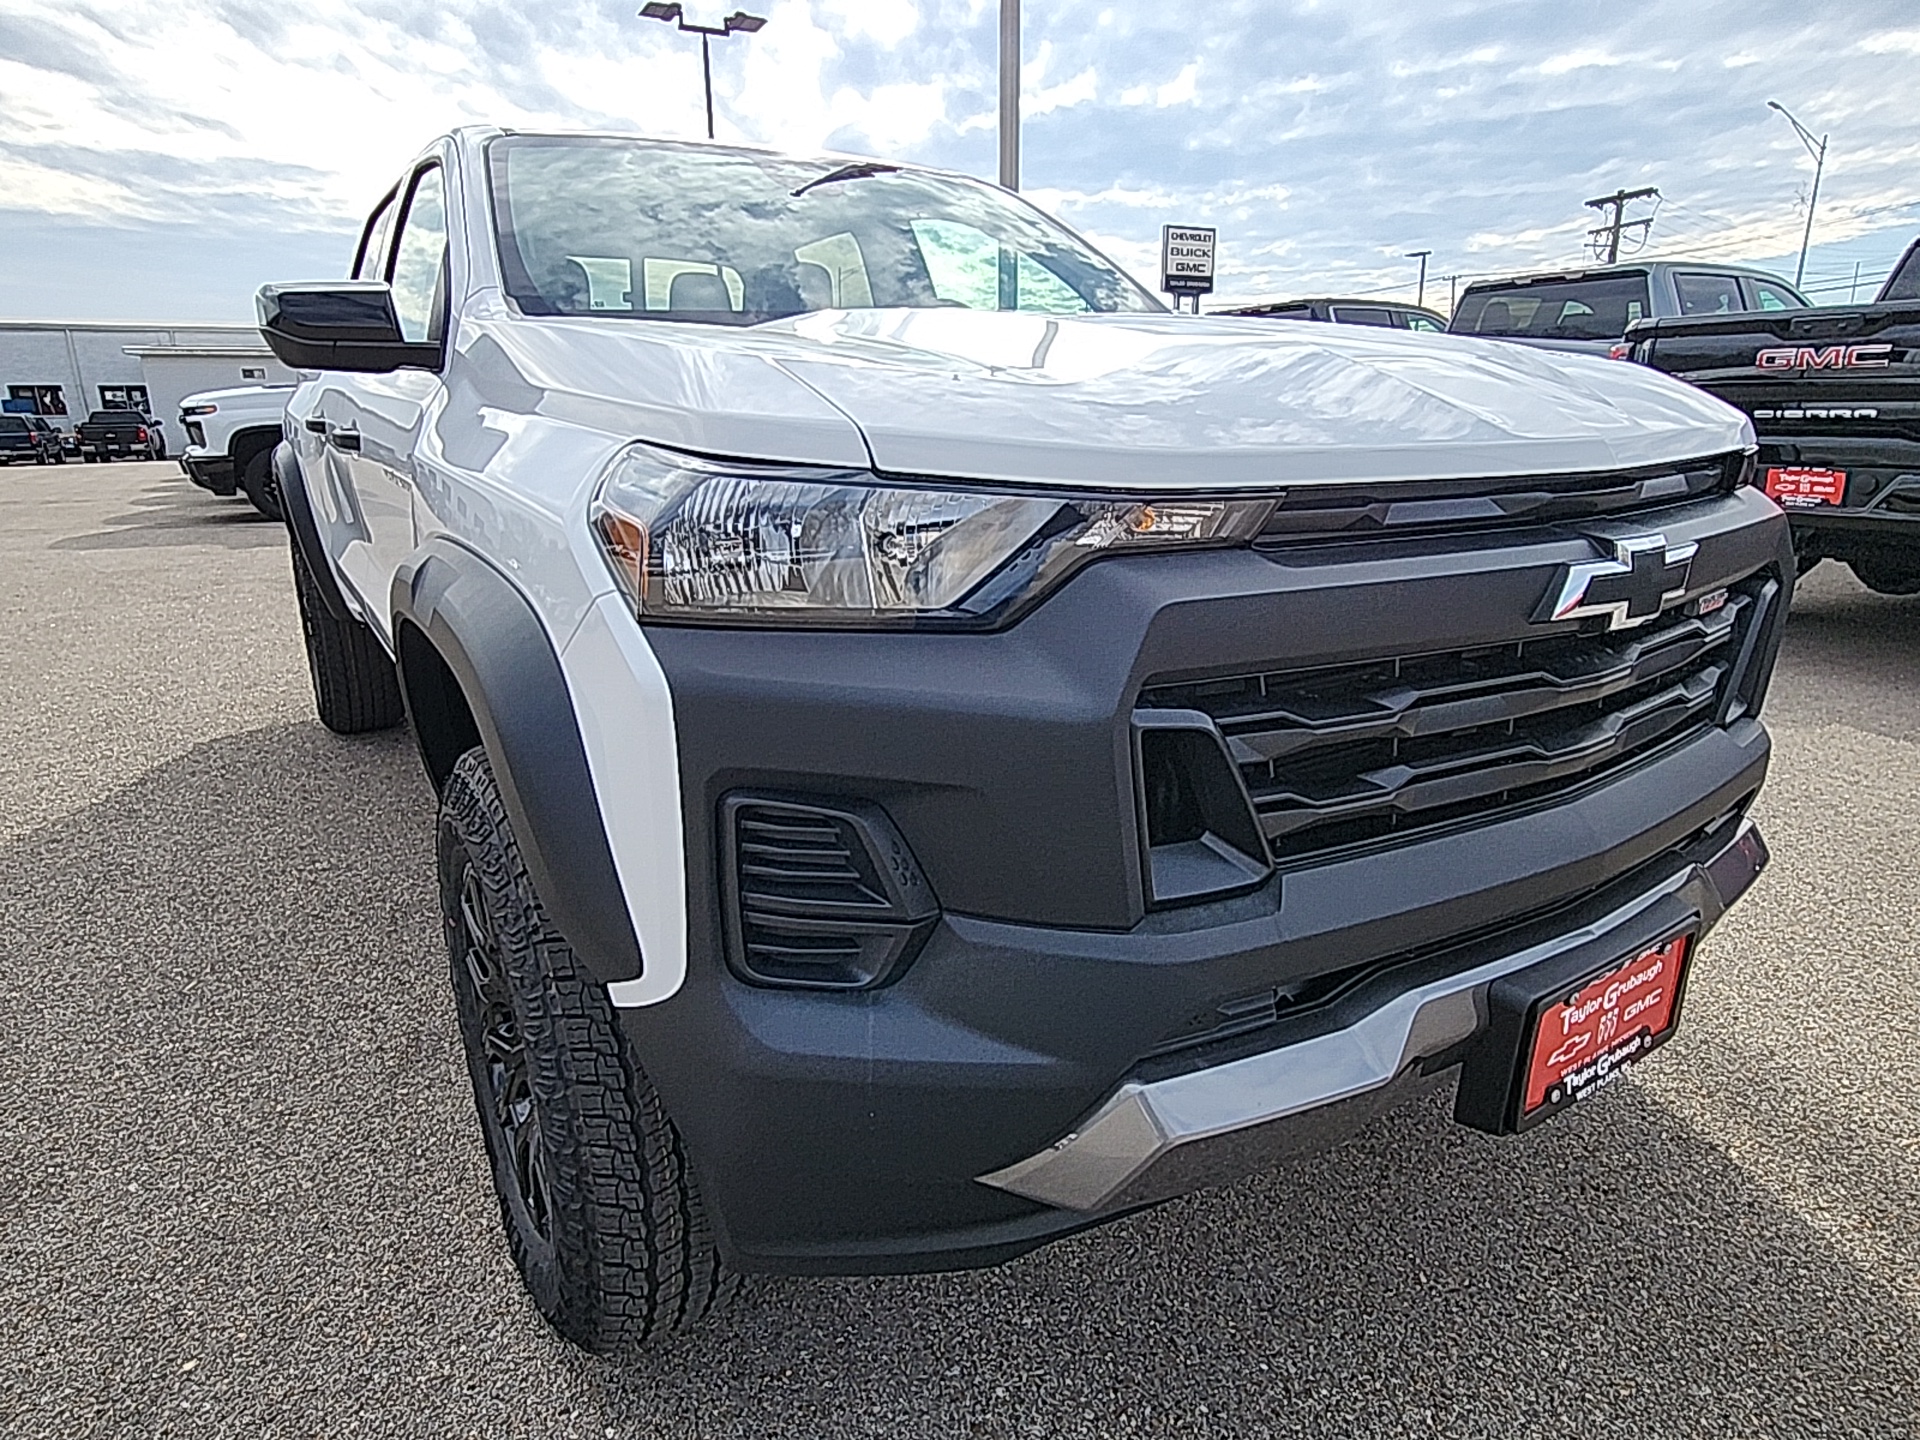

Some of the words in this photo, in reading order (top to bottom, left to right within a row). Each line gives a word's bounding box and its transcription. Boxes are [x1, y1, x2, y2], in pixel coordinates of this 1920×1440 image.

[1171, 232, 1212, 243] CHEVROLET
[1170, 247, 1211, 258] BUICK
[1175, 263, 1206, 273] GMC
[1756, 344, 1893, 371] GMC
[1753, 409, 1878, 419] SIERRA
[1561, 996, 1602, 1035] Taylor
[1603, 959, 1663, 1010] Grubaugh
[1623, 988, 1663, 1021] GMC
[1563, 1065, 1597, 1095] Taylor
[1597, 1035, 1641, 1076] Grubaugh
